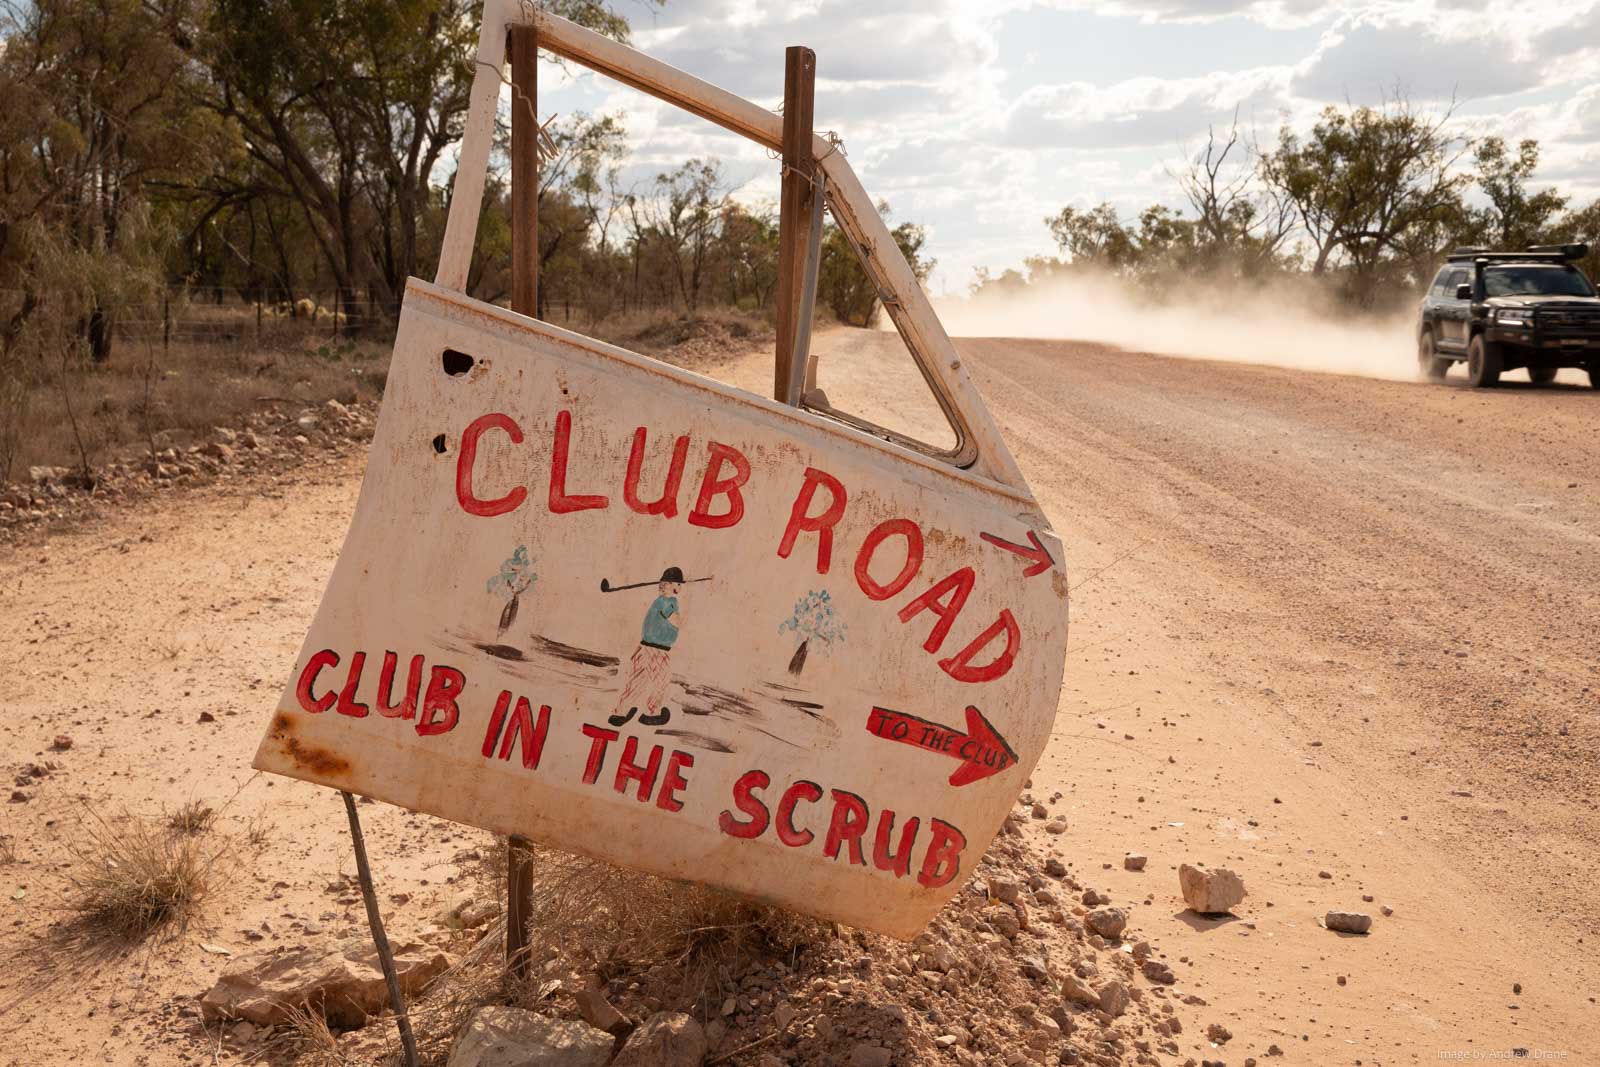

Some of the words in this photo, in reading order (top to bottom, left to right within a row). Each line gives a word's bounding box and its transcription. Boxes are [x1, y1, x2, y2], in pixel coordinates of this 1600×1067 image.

[456, 410, 751, 530] CLUB
[777, 467, 1021, 684] ROAD
[296, 650, 467, 737] CLUB
[481, 691, 552, 770] IN
[582, 723, 695, 813] THE
[719, 769, 967, 888] SCRUB
[876, 715, 909, 739] TO
[919, 727, 954, 752] THE
[960, 740, 1009, 770] CLUB
